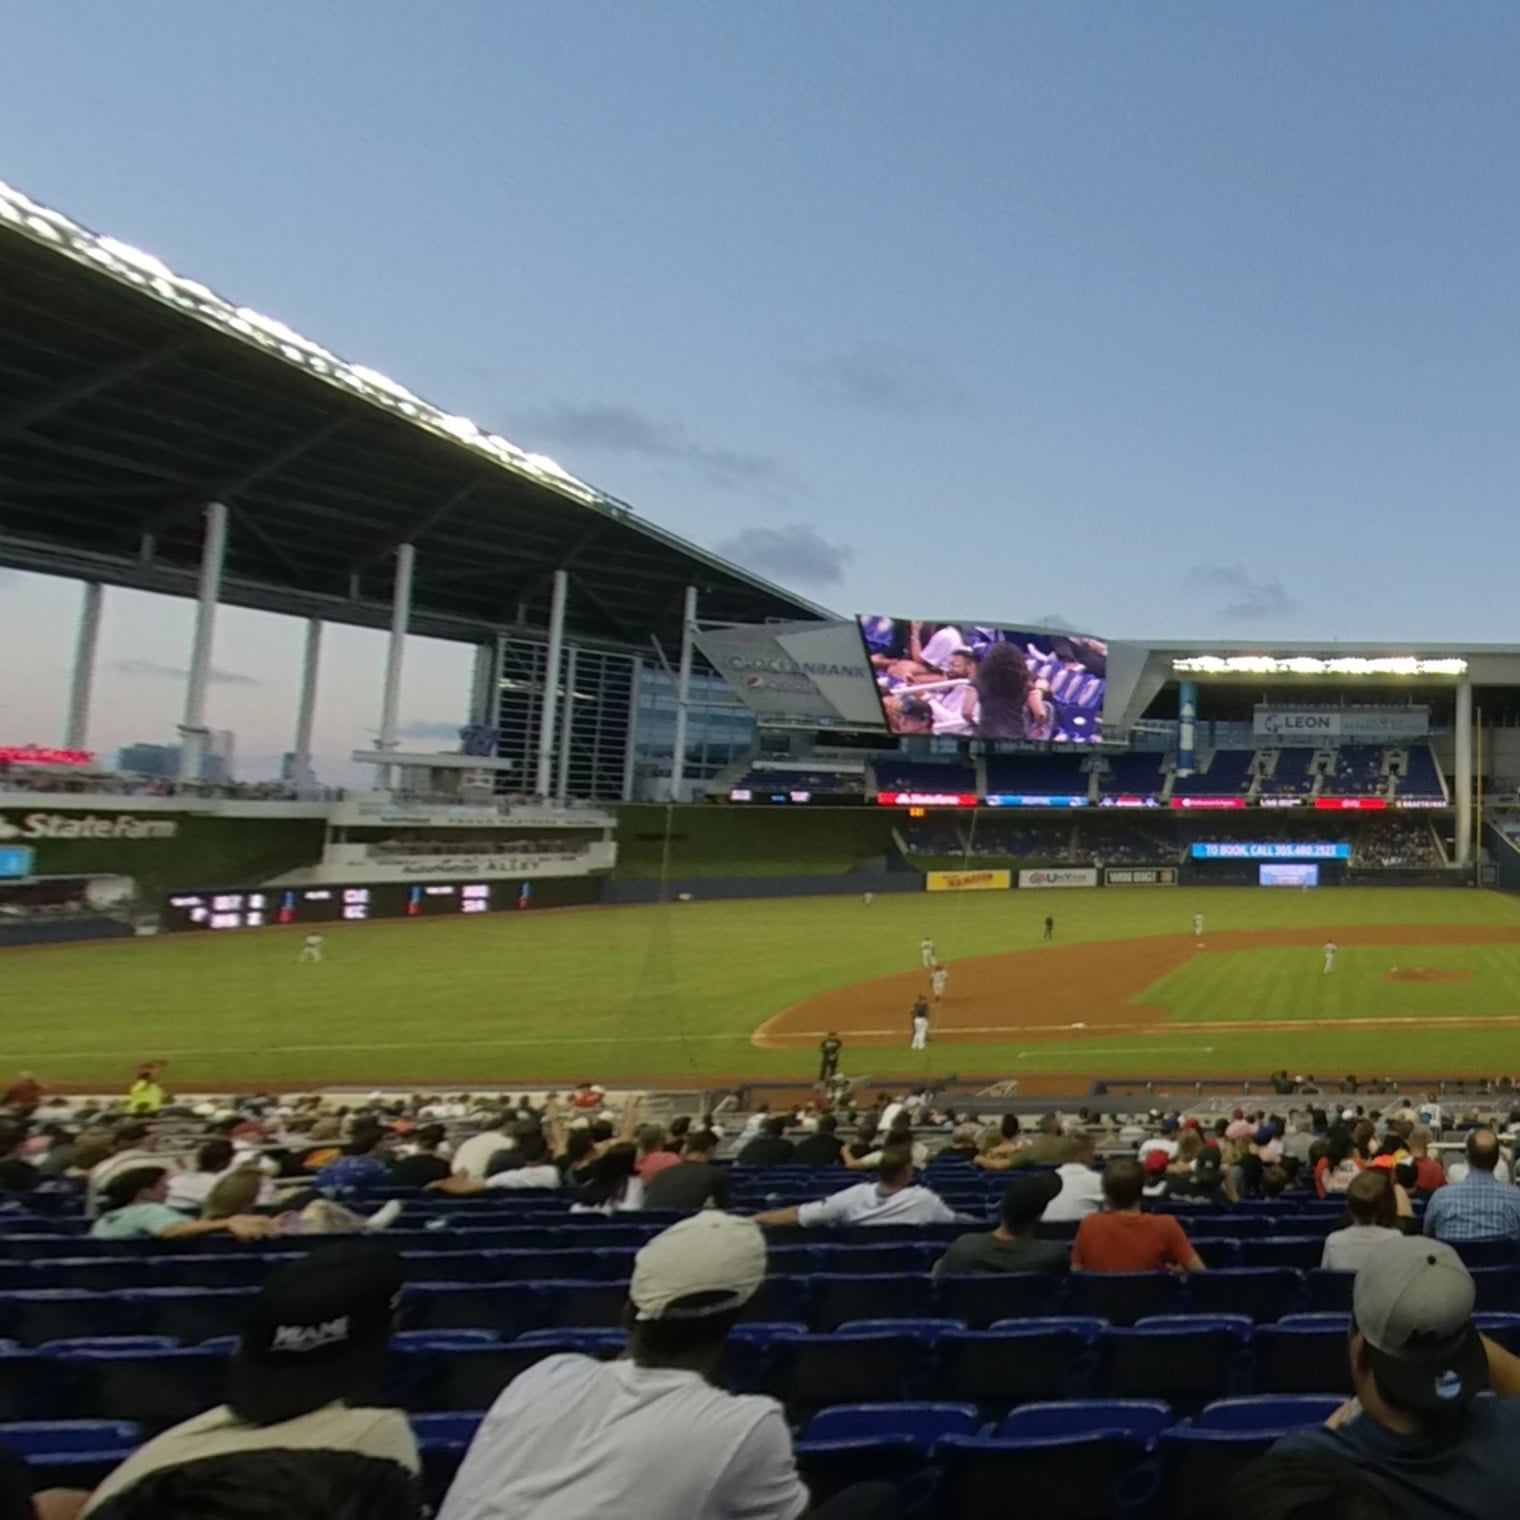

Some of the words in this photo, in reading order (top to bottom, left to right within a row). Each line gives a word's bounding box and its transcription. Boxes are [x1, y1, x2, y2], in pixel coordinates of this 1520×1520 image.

[1284, 716, 1331, 729] LEON
[1250, 844, 1273, 857] CALL
[1109, 871, 1132, 883] WIN
